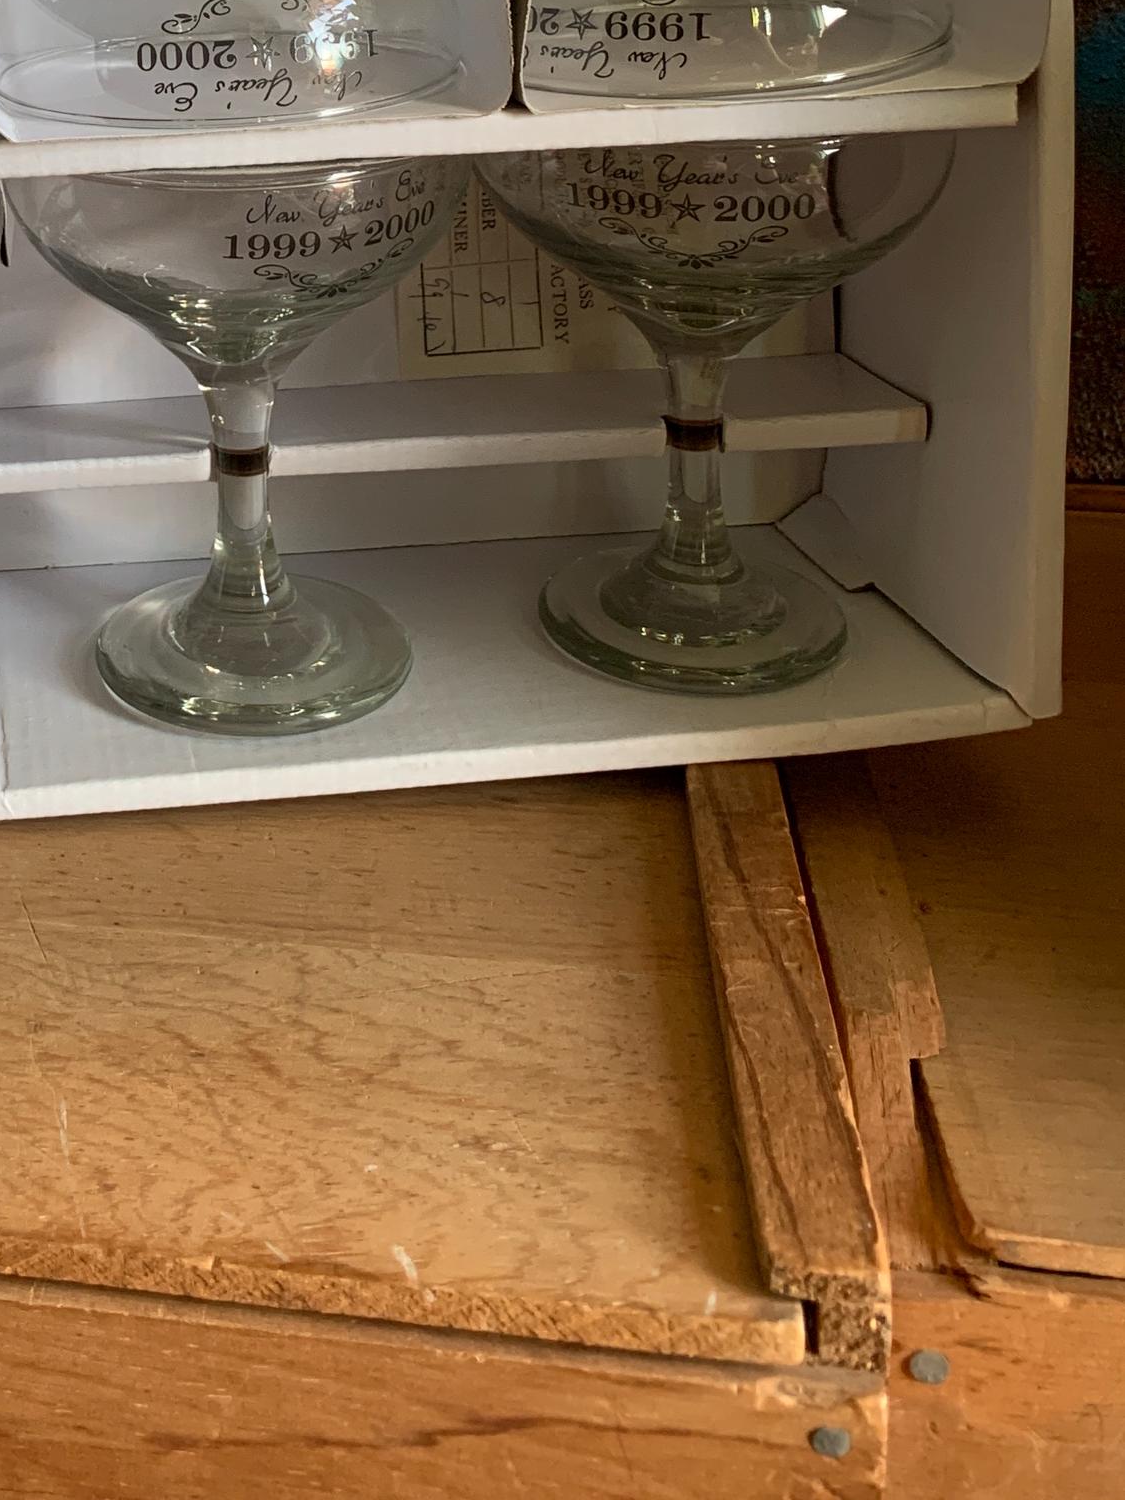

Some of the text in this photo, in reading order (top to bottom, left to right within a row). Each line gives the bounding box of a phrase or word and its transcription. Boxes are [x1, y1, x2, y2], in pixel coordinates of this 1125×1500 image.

[605, 10, 712, 42] 1999
[136, 39, 237, 72] 2000
[540, 40, 615, 79] Year's
[628, 50, 687, 80] New
[154, 81, 198, 113] Eve
[215, 68, 298, 110] Year's
[584, 148, 639, 180] New
[653, 153, 739, 192] Year's
[246, 194, 300, 225] New
[565, 182, 816, 222] 1999 2000
[222, 200, 435, 260] 1999 2000
